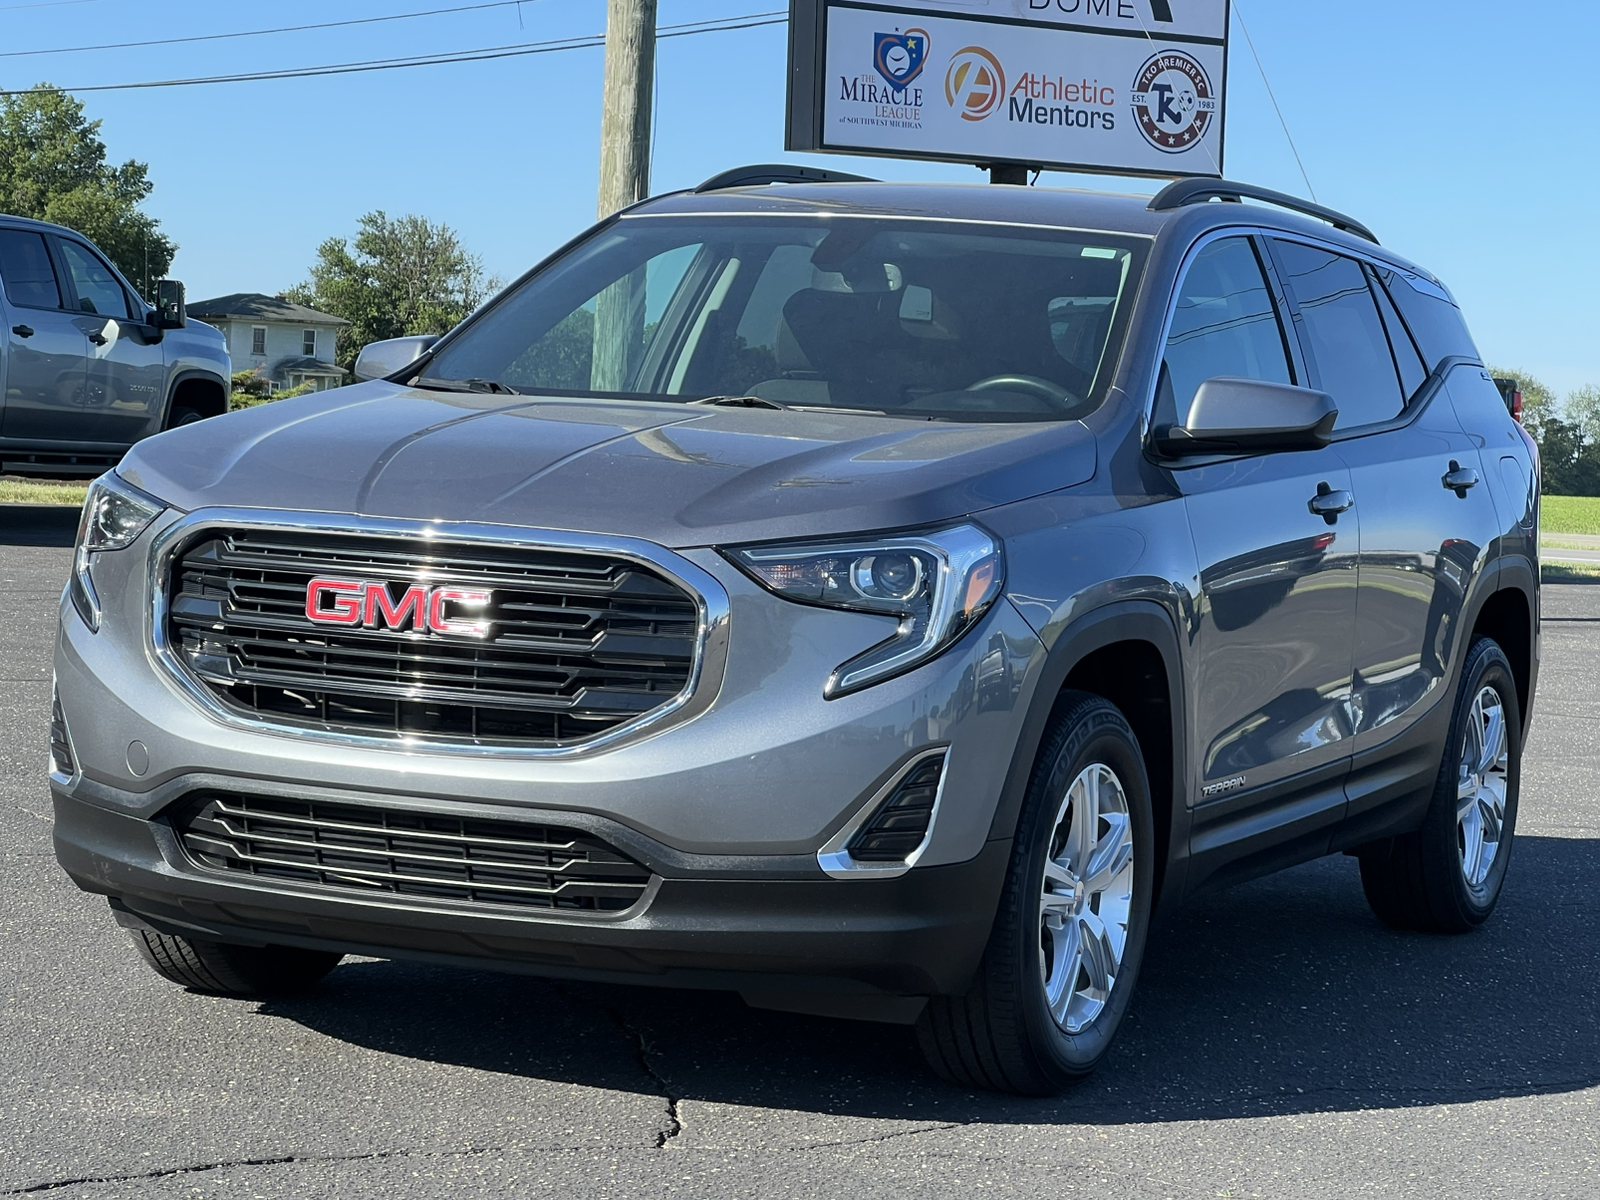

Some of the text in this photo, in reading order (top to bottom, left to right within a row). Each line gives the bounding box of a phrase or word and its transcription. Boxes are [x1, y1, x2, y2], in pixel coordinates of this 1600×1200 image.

[861, 74, 876, 83] THE
[1141, 57, 1205, 90] TKO PREMIER SC
[840, 76, 923, 107] MIRACLE
[1009, 72, 1115, 106] Athletic
[1132, 94, 1147, 104] EST.
[875, 105, 920, 121] LEAGUE
[1009, 96, 1115, 131] Mentors
[1198, 100, 1215, 109] 1983
[847, 117, 888, 127] SOUTHWEST
[889, 120, 923, 130] MICHIGAN
[304, 574, 494, 640] GMC
[1202, 775, 1247, 798] TERRAIN
